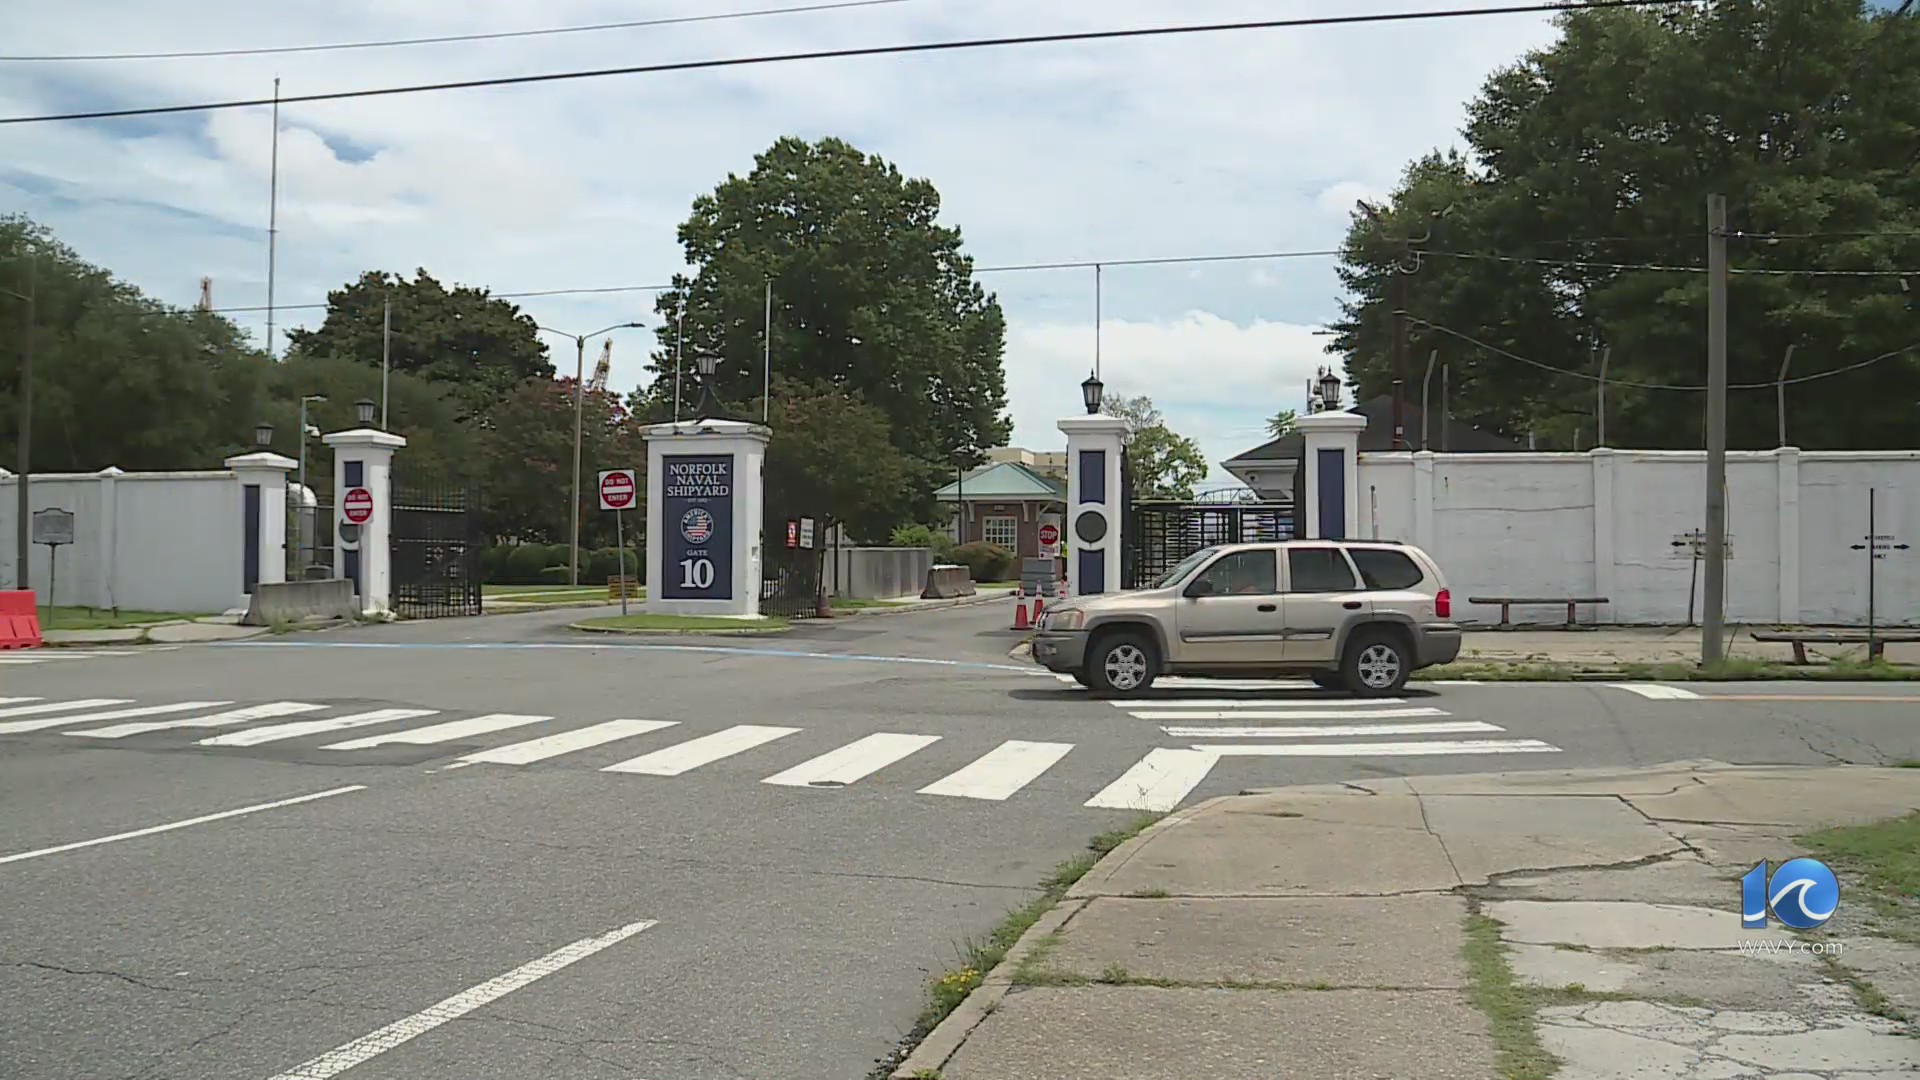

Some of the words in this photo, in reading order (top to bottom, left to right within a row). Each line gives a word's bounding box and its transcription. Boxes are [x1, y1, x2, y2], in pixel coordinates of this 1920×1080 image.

[669, 463, 727, 475] NORFOLK
[676, 475, 720, 485] NAVAL
[667, 485, 729, 497] SHIPYARD
[1040, 530, 1058, 540] STOP
[686, 549, 708, 557] GATE
[680, 558, 715, 589] 10
